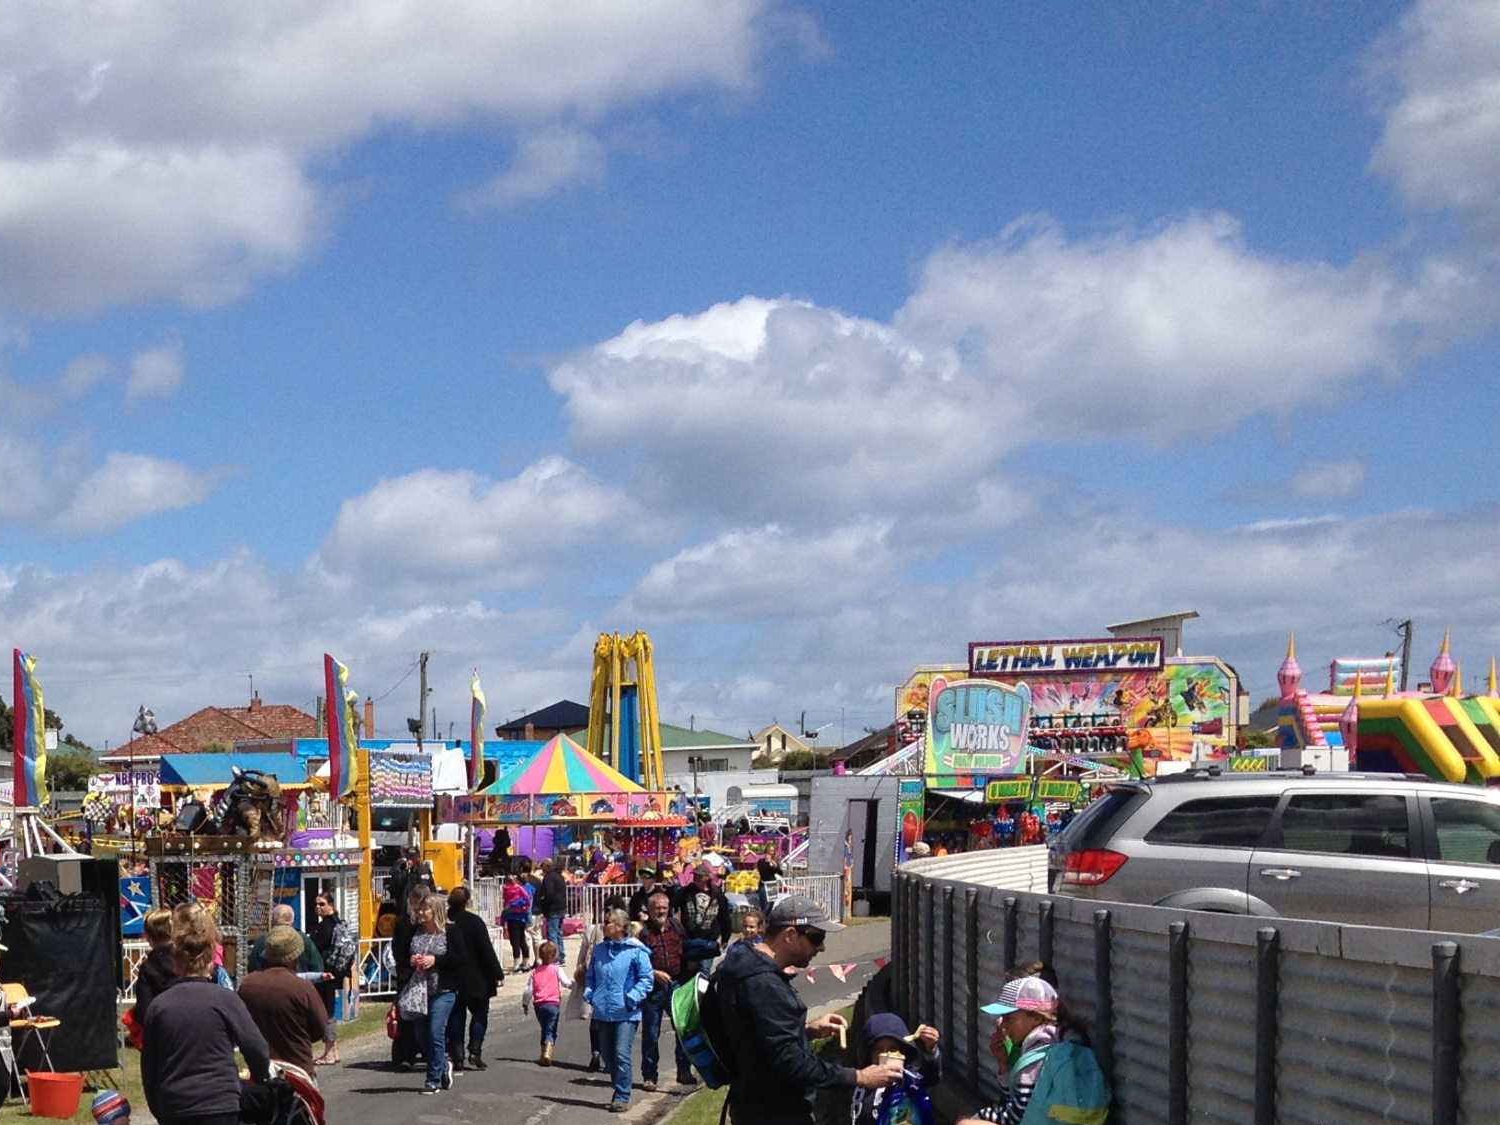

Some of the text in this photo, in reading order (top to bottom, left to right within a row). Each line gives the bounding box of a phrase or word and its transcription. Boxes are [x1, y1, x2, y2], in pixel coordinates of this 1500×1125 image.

[974, 643, 1159, 671] LETHAL WEAPON
[936, 686, 1025, 736] SLUSH
[950, 722, 1011, 751] WORKS
